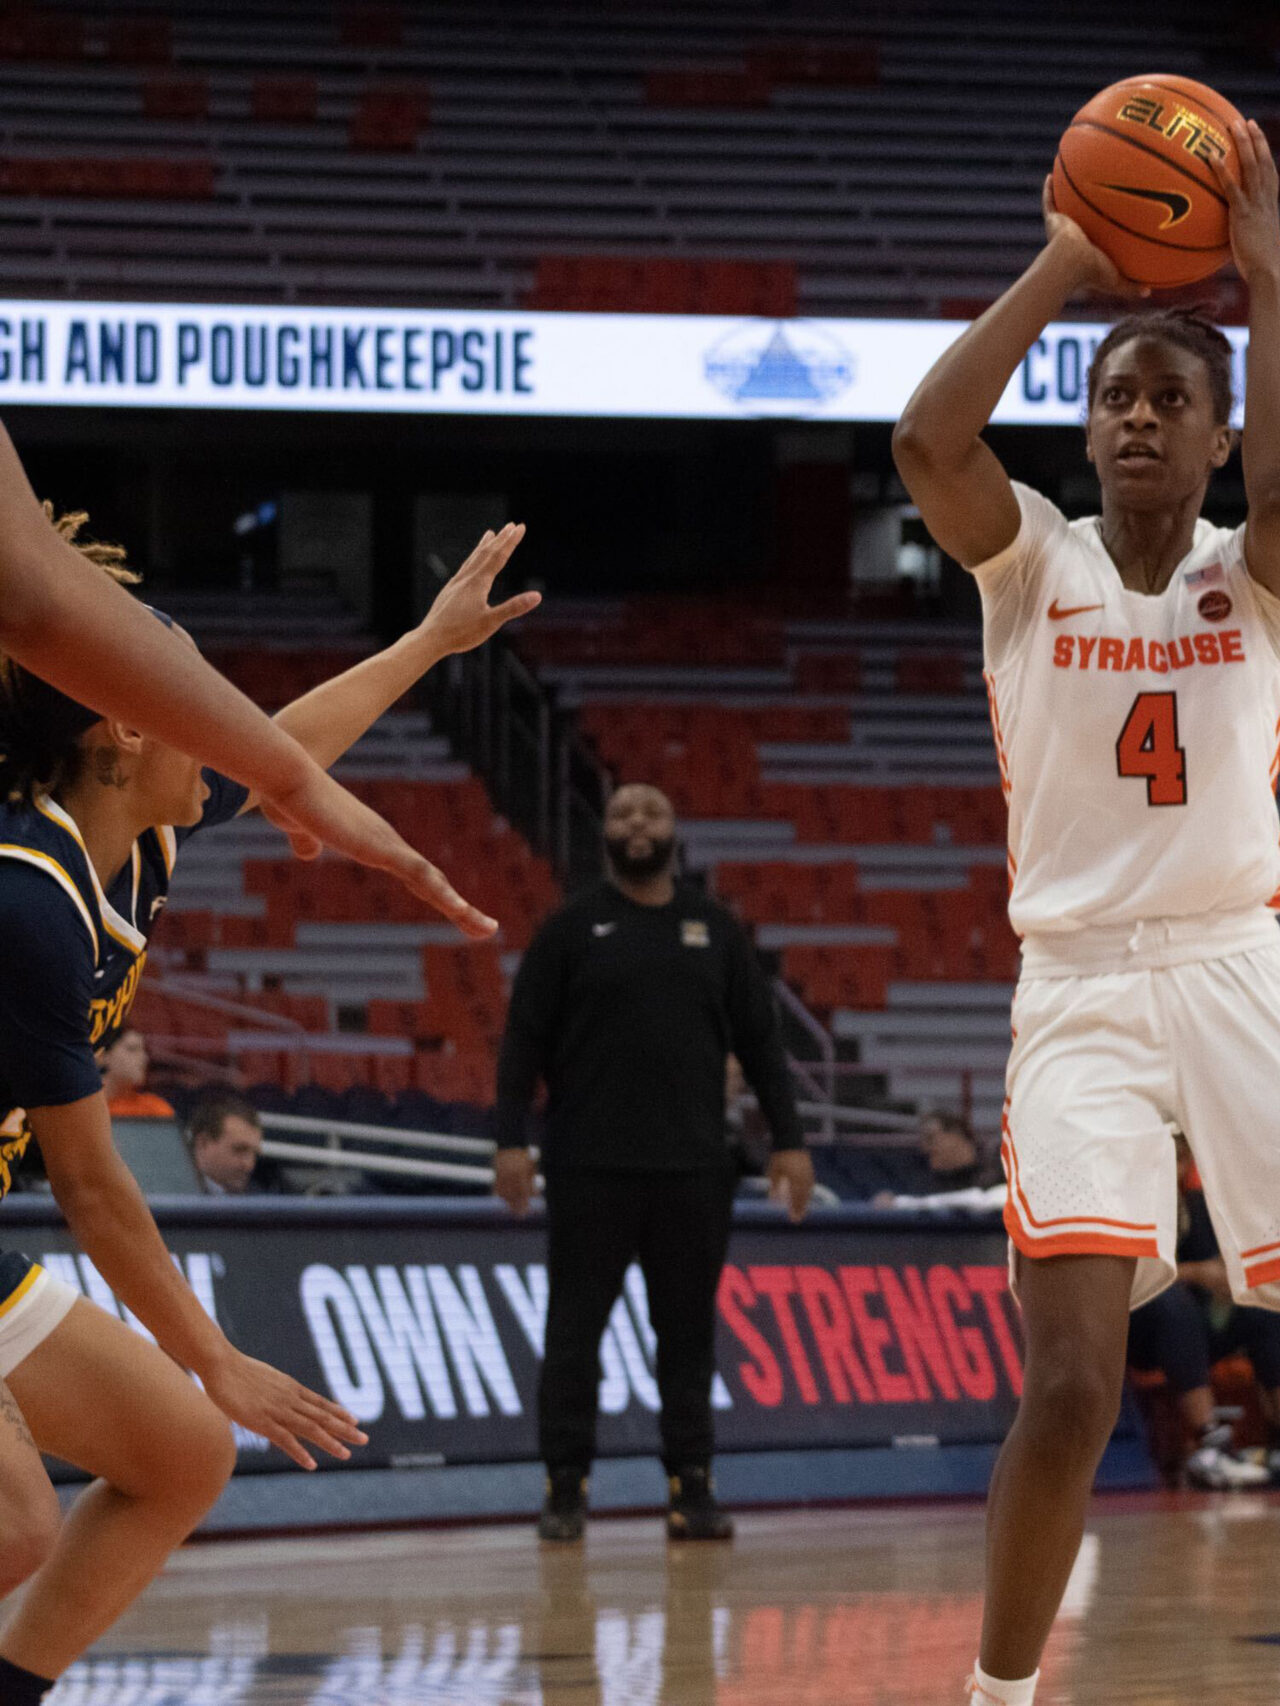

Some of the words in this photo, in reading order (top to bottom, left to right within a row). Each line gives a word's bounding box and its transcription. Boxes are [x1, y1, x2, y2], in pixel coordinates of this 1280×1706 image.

[1116, 97, 1231, 165] ELITE
[65, 319, 158, 385] AND
[177, 322, 533, 393] POUGHKEEPSIE
[1053, 630, 1245, 673] SYRACUSE
[1115, 690, 1187, 806] 4
[300, 1263, 524, 1422] OWN
[715, 1264, 1024, 1407] STRENGT
